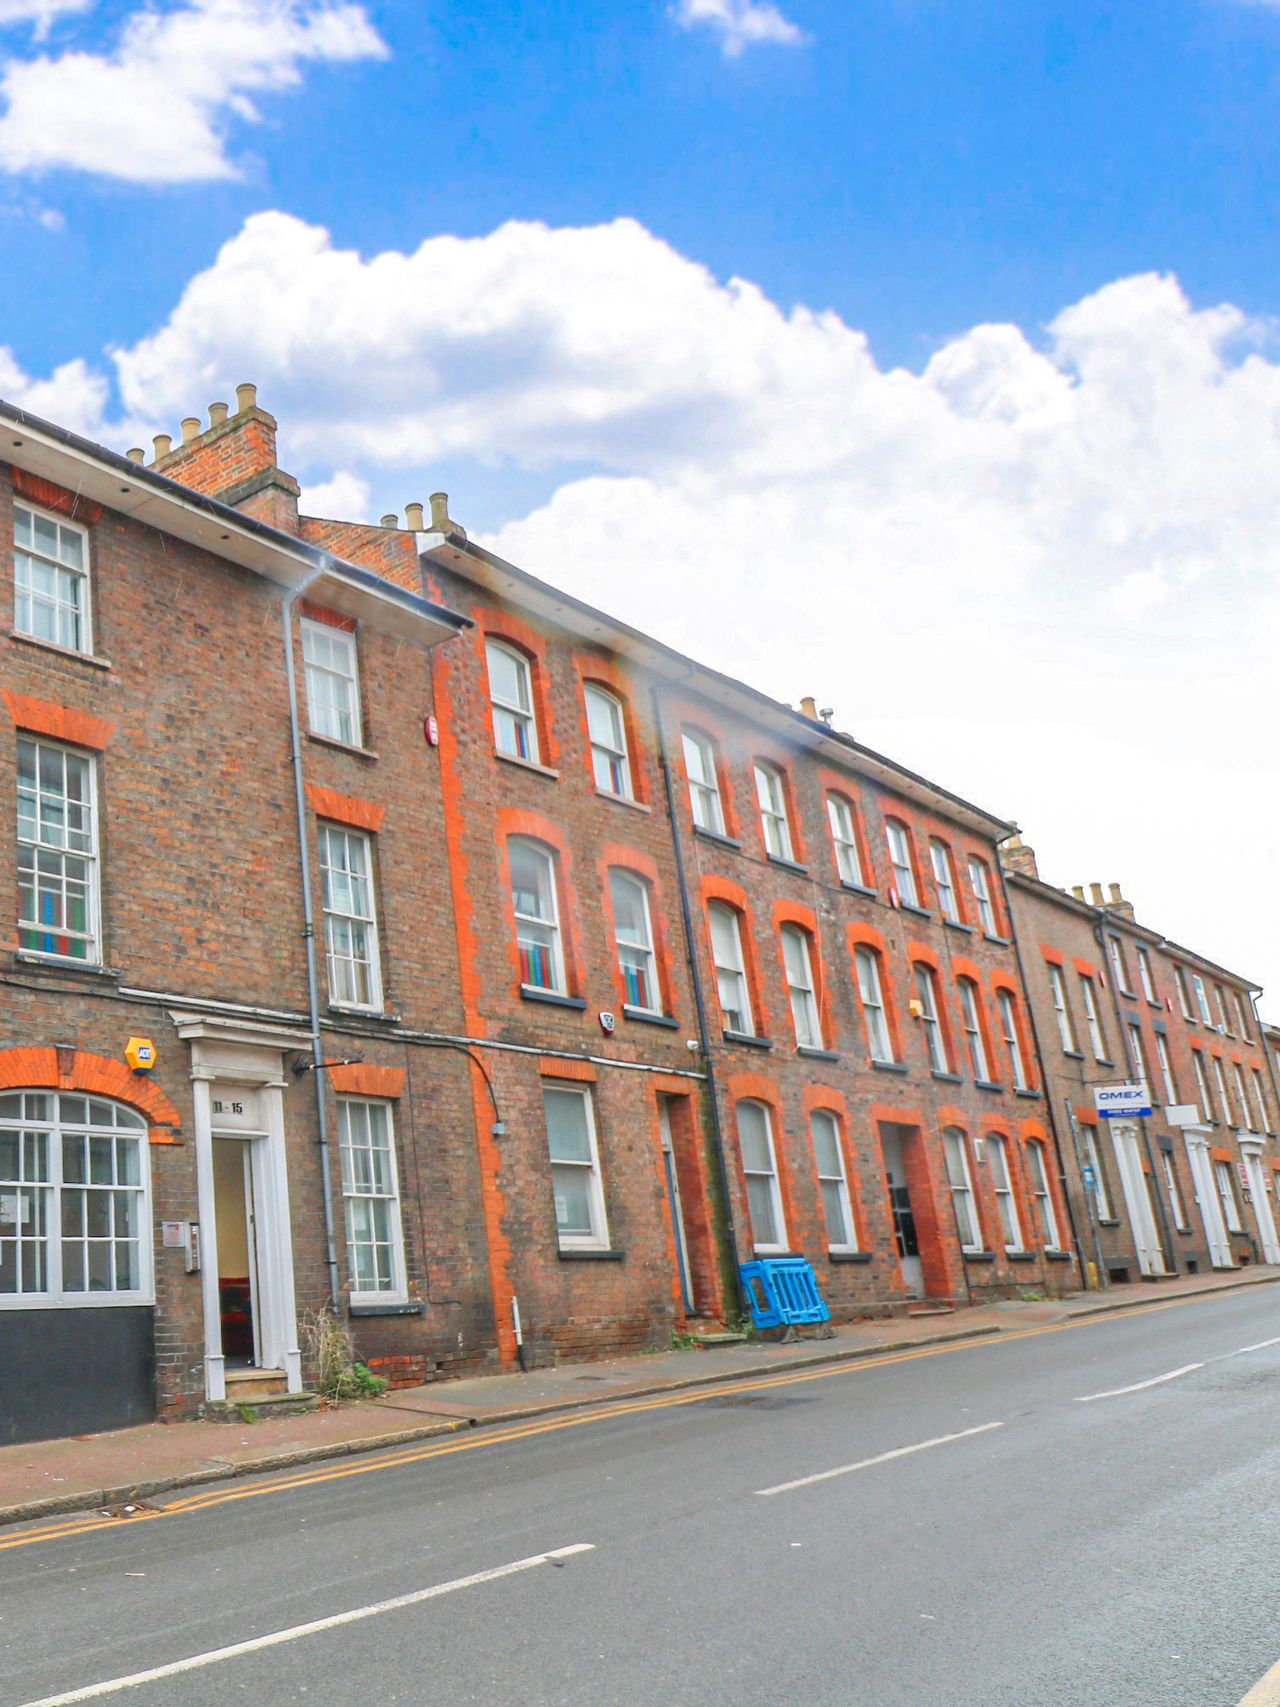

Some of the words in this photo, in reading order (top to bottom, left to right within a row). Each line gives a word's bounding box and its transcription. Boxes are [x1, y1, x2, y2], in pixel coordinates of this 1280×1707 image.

[139, 1048, 150, 1058] ADT
[1098, 1090, 1143, 1100] OMEX
[213, 1101, 223, 1112] 11
[231, 1102, 243, 1114] 15
